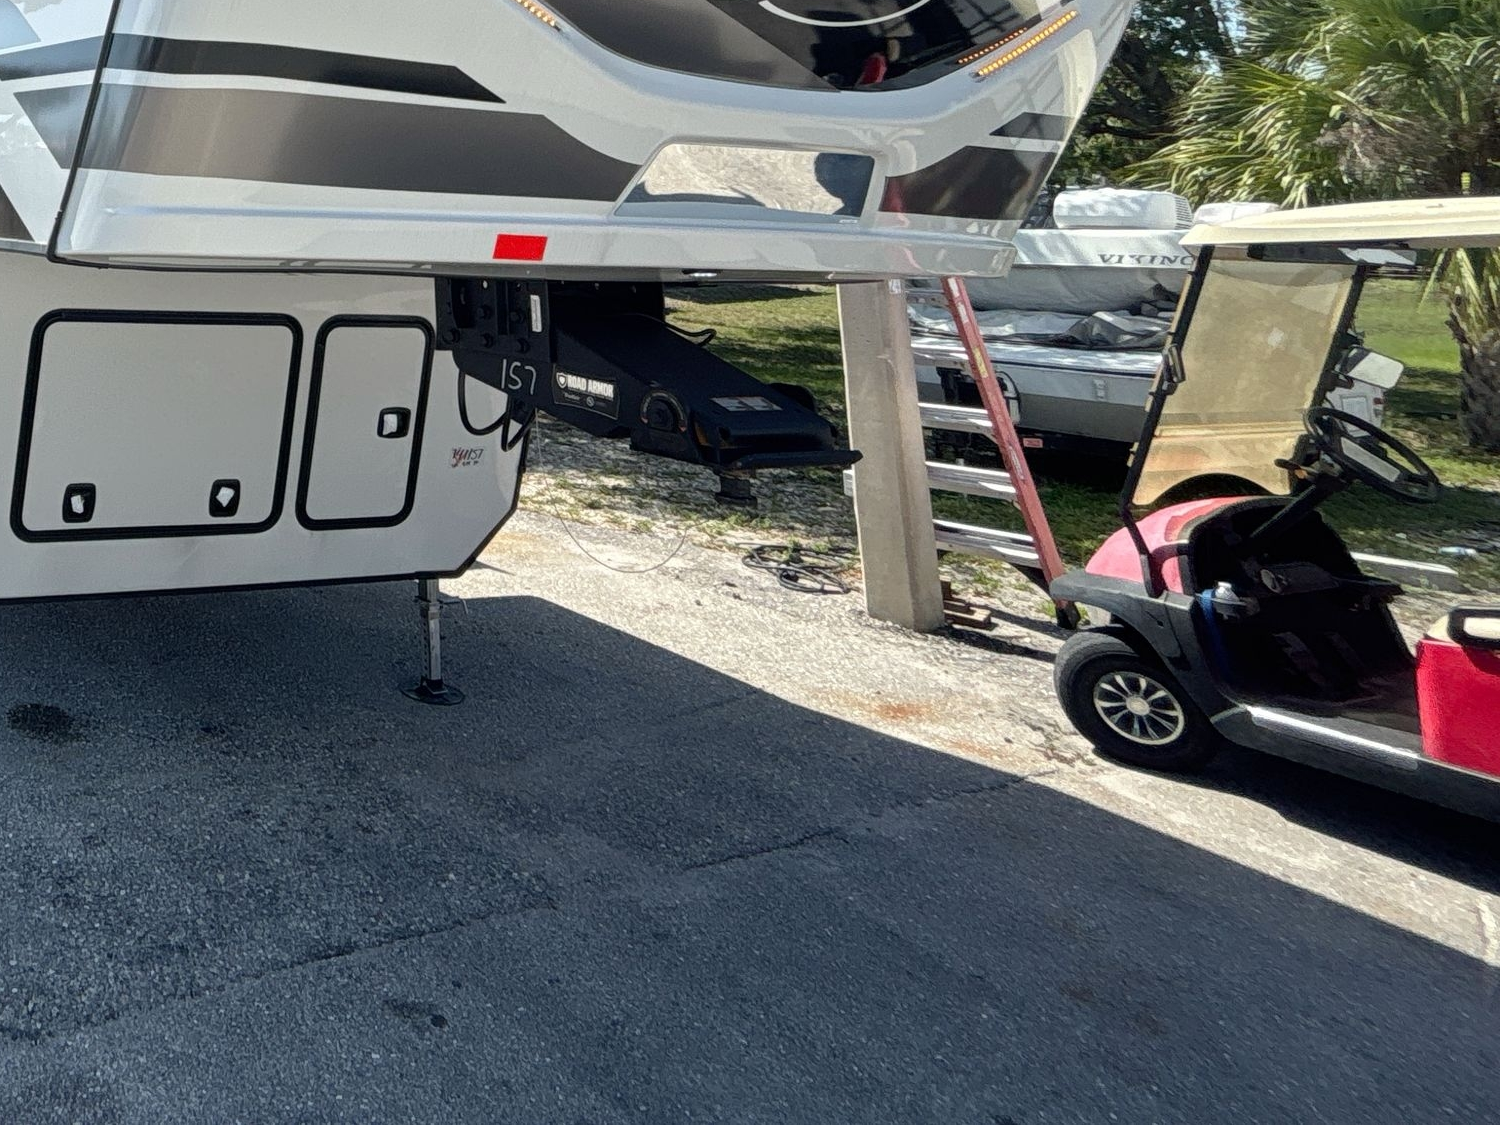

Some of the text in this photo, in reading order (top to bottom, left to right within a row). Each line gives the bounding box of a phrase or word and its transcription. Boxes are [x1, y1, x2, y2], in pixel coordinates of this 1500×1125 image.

[501, 358, 536, 395] 157
[567, 374, 587, 391] ROAD
[587, 379, 614, 398] ARMOR
